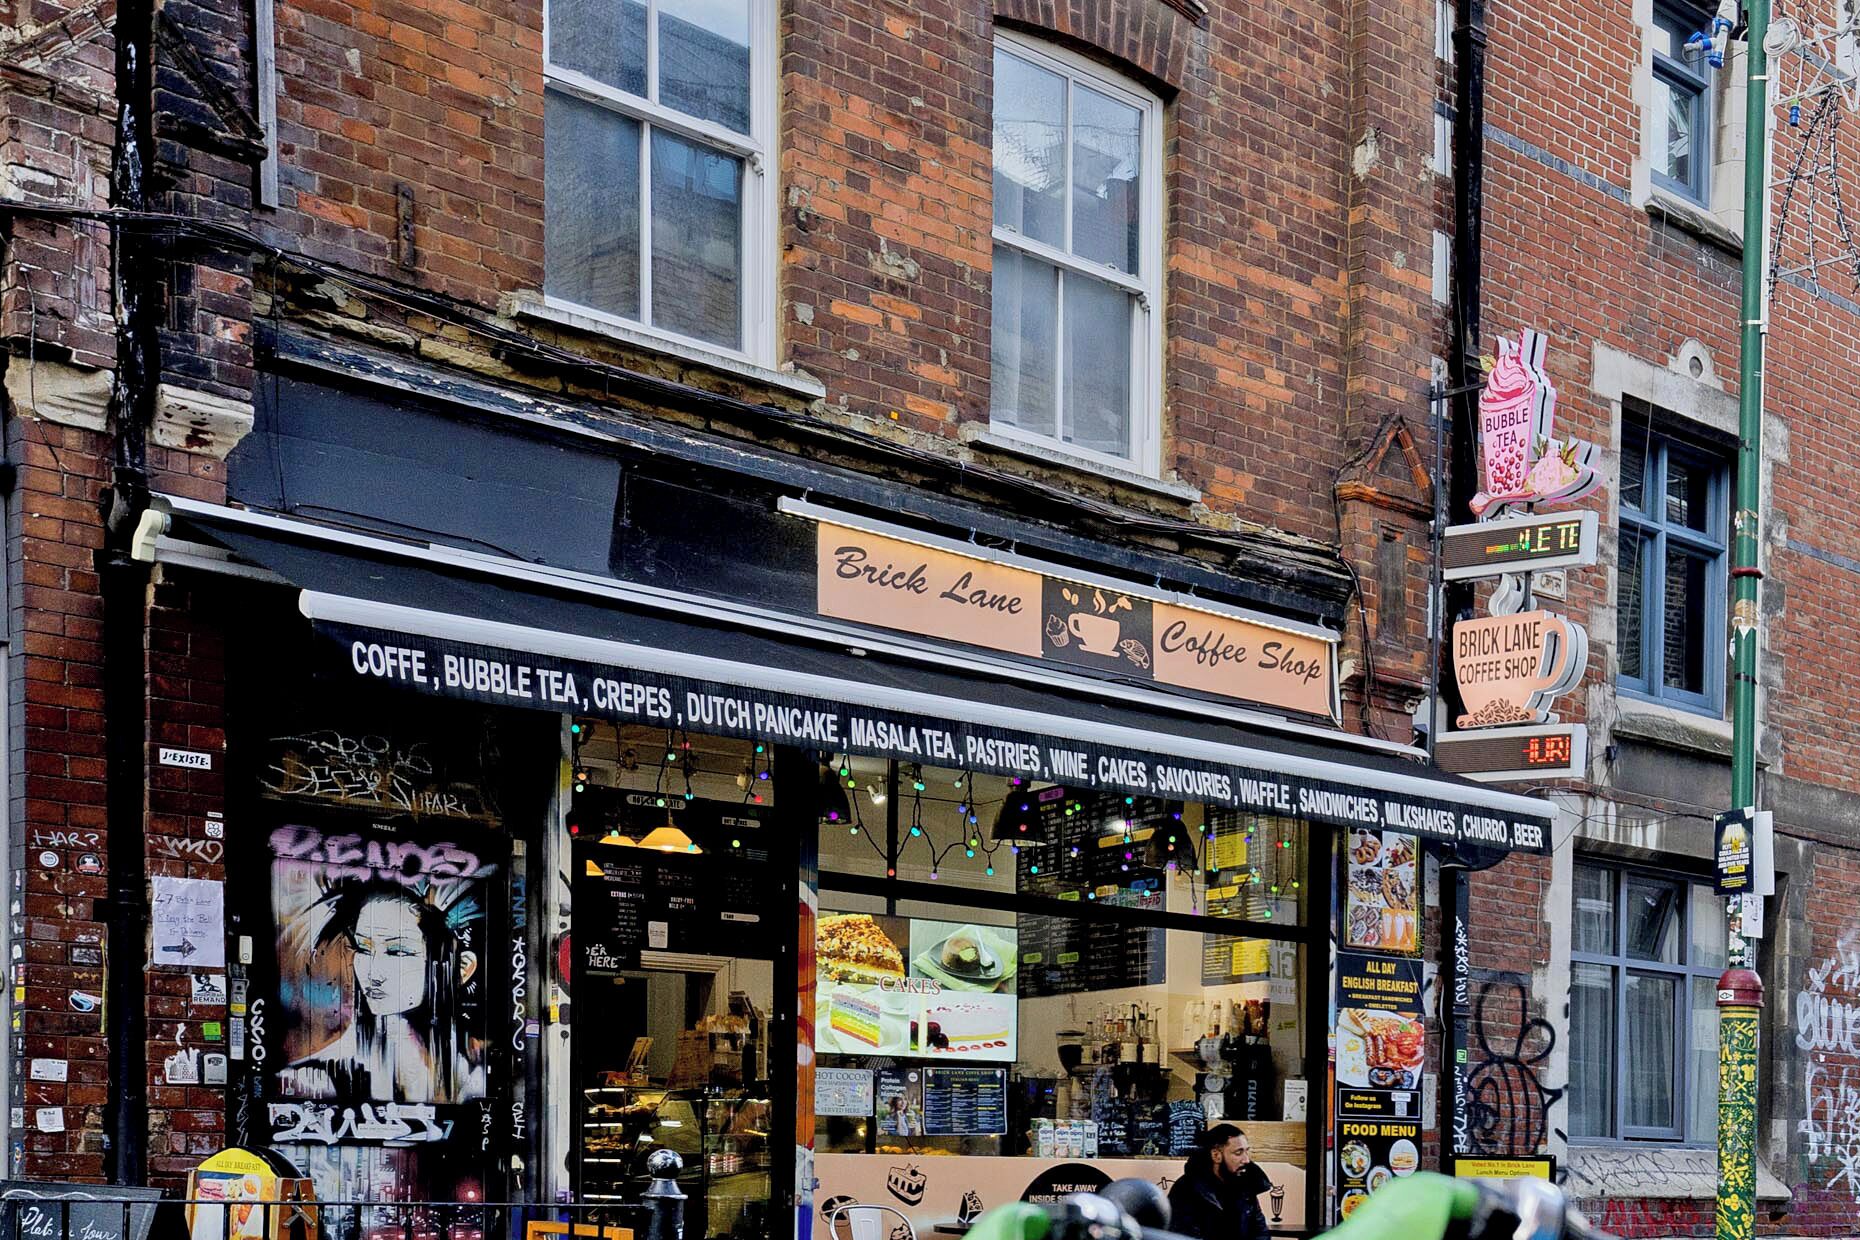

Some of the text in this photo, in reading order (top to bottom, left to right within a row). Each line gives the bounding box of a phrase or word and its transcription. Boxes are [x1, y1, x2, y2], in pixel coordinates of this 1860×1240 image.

[1485, 407, 1529, 433] BUBBLE
[1497, 430, 1517, 449] TEA
[834, 546, 1024, 615] Brick Lane
[1459, 621, 1541, 659] BRICK LANE
[1159, 620, 1324, 681] Coffee Shop
[1459, 656, 1537, 685] COFFEE SHOP
[162, 750, 209, 767] J'EXISTE.
[444, 654, 533, 698] BUBBLE
[687, 691, 751, 729] DUTCH
[851, 717, 922, 755] MASALA
[1514, 822, 1543, 849] BEER
[588, 956, 618, 969] HERE
[1366, 961, 1396, 975] ALL DAY
[879, 974, 942, 996] CAKES
[1342, 976, 1418, 994] ENGLISH BREAKFAST
[815, 1072, 868, 1082] HOT COCOA
[1343, 1124, 1417, 1137] FOOD MENU
[1052, 1183, 1098, 1193] TAKE AWAY
[1029, 1195, 1055, 1204] INSIDE
